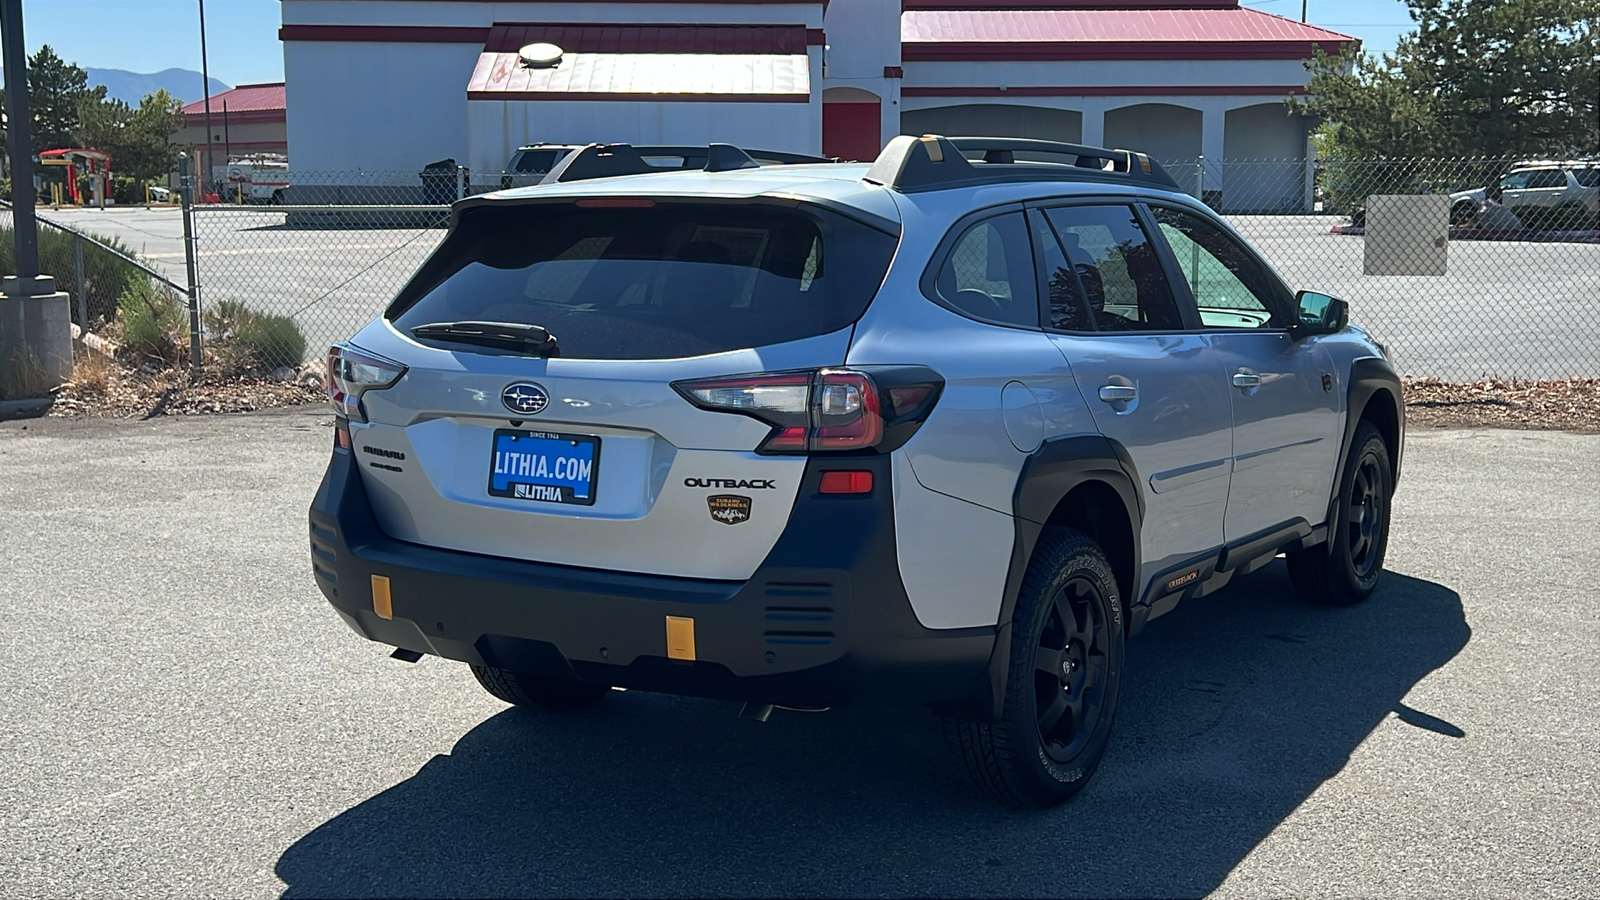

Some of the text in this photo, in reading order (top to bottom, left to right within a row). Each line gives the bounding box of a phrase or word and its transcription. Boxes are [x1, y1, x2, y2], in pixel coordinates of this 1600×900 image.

[529, 431, 546, 439] SINCE
[363, 445, 405, 460] SUBARU
[494, 451, 592, 482] LITHIA.COM
[684, 478, 776, 489] OUTBACK
[525, 485, 562, 501] LITHIA
[1168, 571, 1198, 589] OUTBACK
